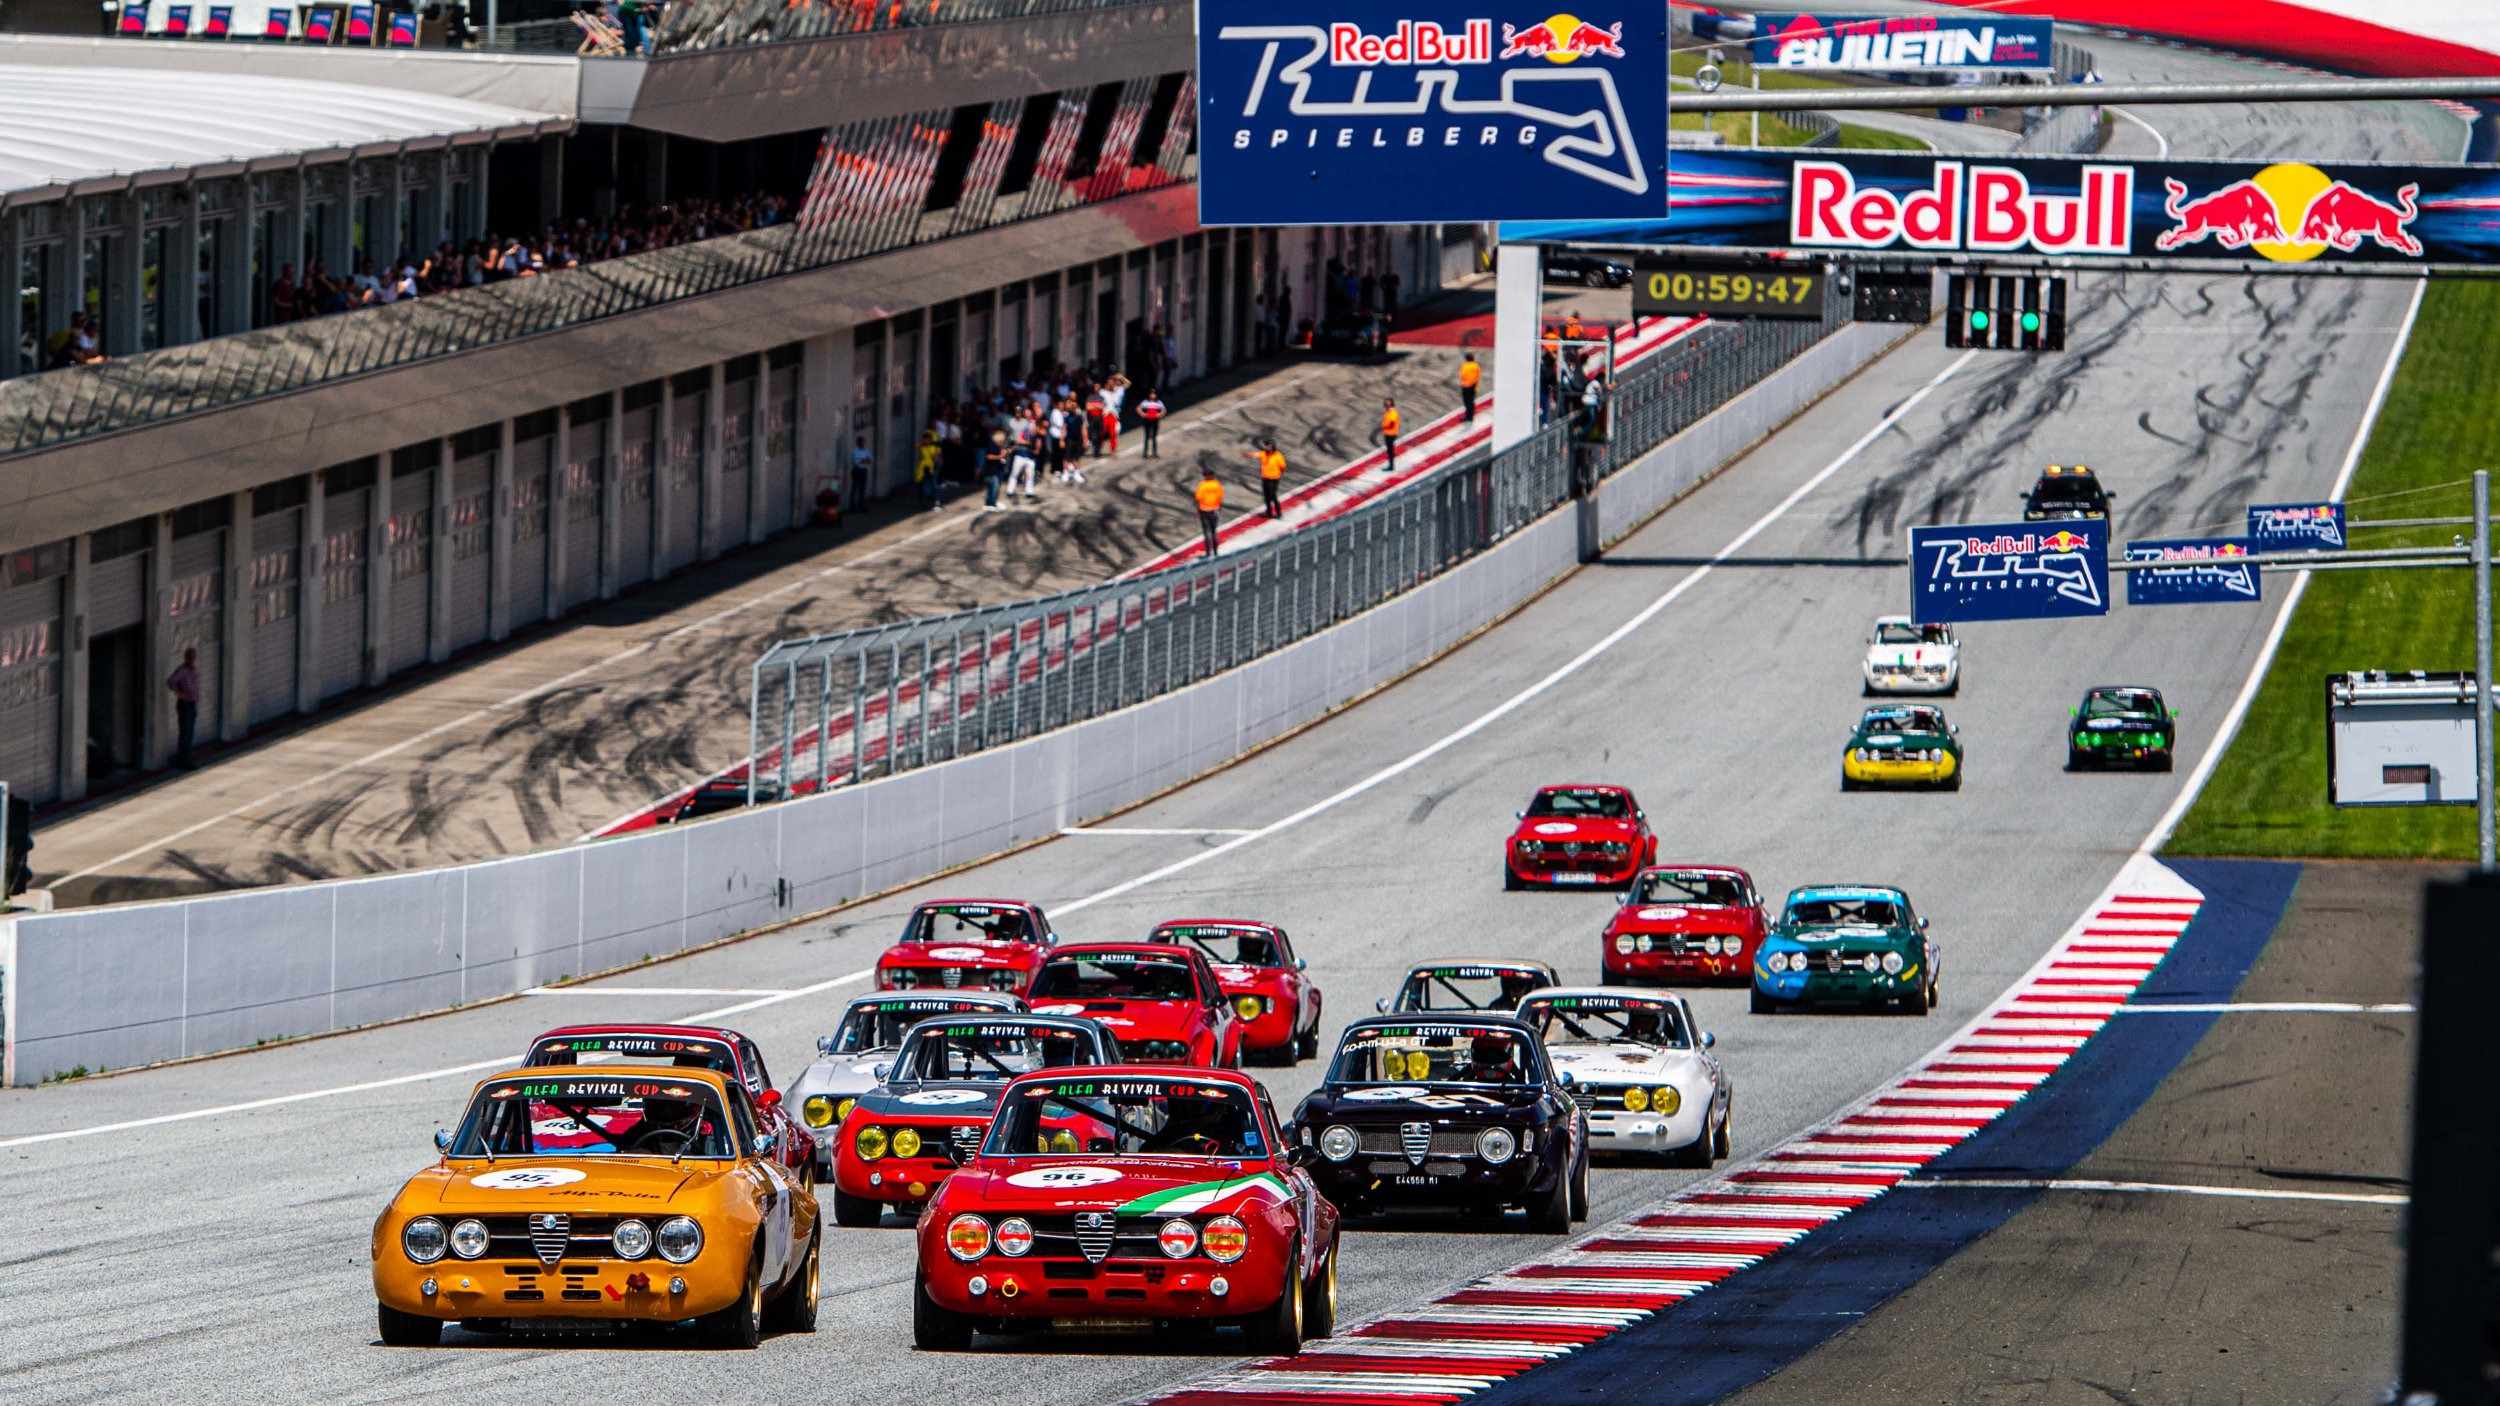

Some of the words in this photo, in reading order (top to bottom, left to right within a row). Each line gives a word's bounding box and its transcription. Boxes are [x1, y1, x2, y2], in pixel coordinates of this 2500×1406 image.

[1885, 17, 1937, 34] RED
[1332, 21, 1410, 65] Red
[1414, 20, 1491, 63] Bull
[1233, 125, 1538, 149] SPIELBERG
[1794, 164, 1959, 246] Red
[1969, 168, 2131, 251] Bull
[1649, 273, 1812, 304] 00:59:47
[1968, 535, 2001, 556] Red
[2002, 533, 2035, 554] Bull
[1928, 578, 2054, 592] SPIELBERG
[880, 1003, 904, 1011] ALFA
[909, 1002, 949, 1011] REVIVAL
[954, 1003, 972, 1011] CUP
[1553, 999, 1577, 1007] ALFA
[1582, 998, 1620, 1007] REVIVAL
[1624, 1000, 1641, 1008] CUP
[947, 1026, 975, 1036] ALFA
[981, 1026, 1026, 1036] REVIVAL
[1032, 1028, 1052, 1037] CUP
[1382, 1028, 1410, 1036] ALFA
[1416, 1027, 1461, 1037] REVIVAL
[1466, 1029, 1487, 1037] CUP
[572, 1040, 601, 1051] ALFA
[607, 1040, 657, 1050] REVIVAL
[663, 1041, 684, 1051] CUP
[1410, 1036, 1430, 1047] GT
[522, 1084, 559, 1096] ALFA
[567, 1083, 626, 1096] REVIVAL
[634, 1084, 660, 1096] CUP
[1057, 1084, 1094, 1096] ALFA
[1101, 1083, 1163, 1096] REVIVAL
[1169, 1085, 1196, 1097] CUP
[1409, 1093, 1506, 1109] 67
[502, 1173, 547, 1182] 95
[1042, 1172, 1087, 1182] 96
[548, 1190, 600, 1198] Alfa
[602, 1190, 662, 1199] Delta
